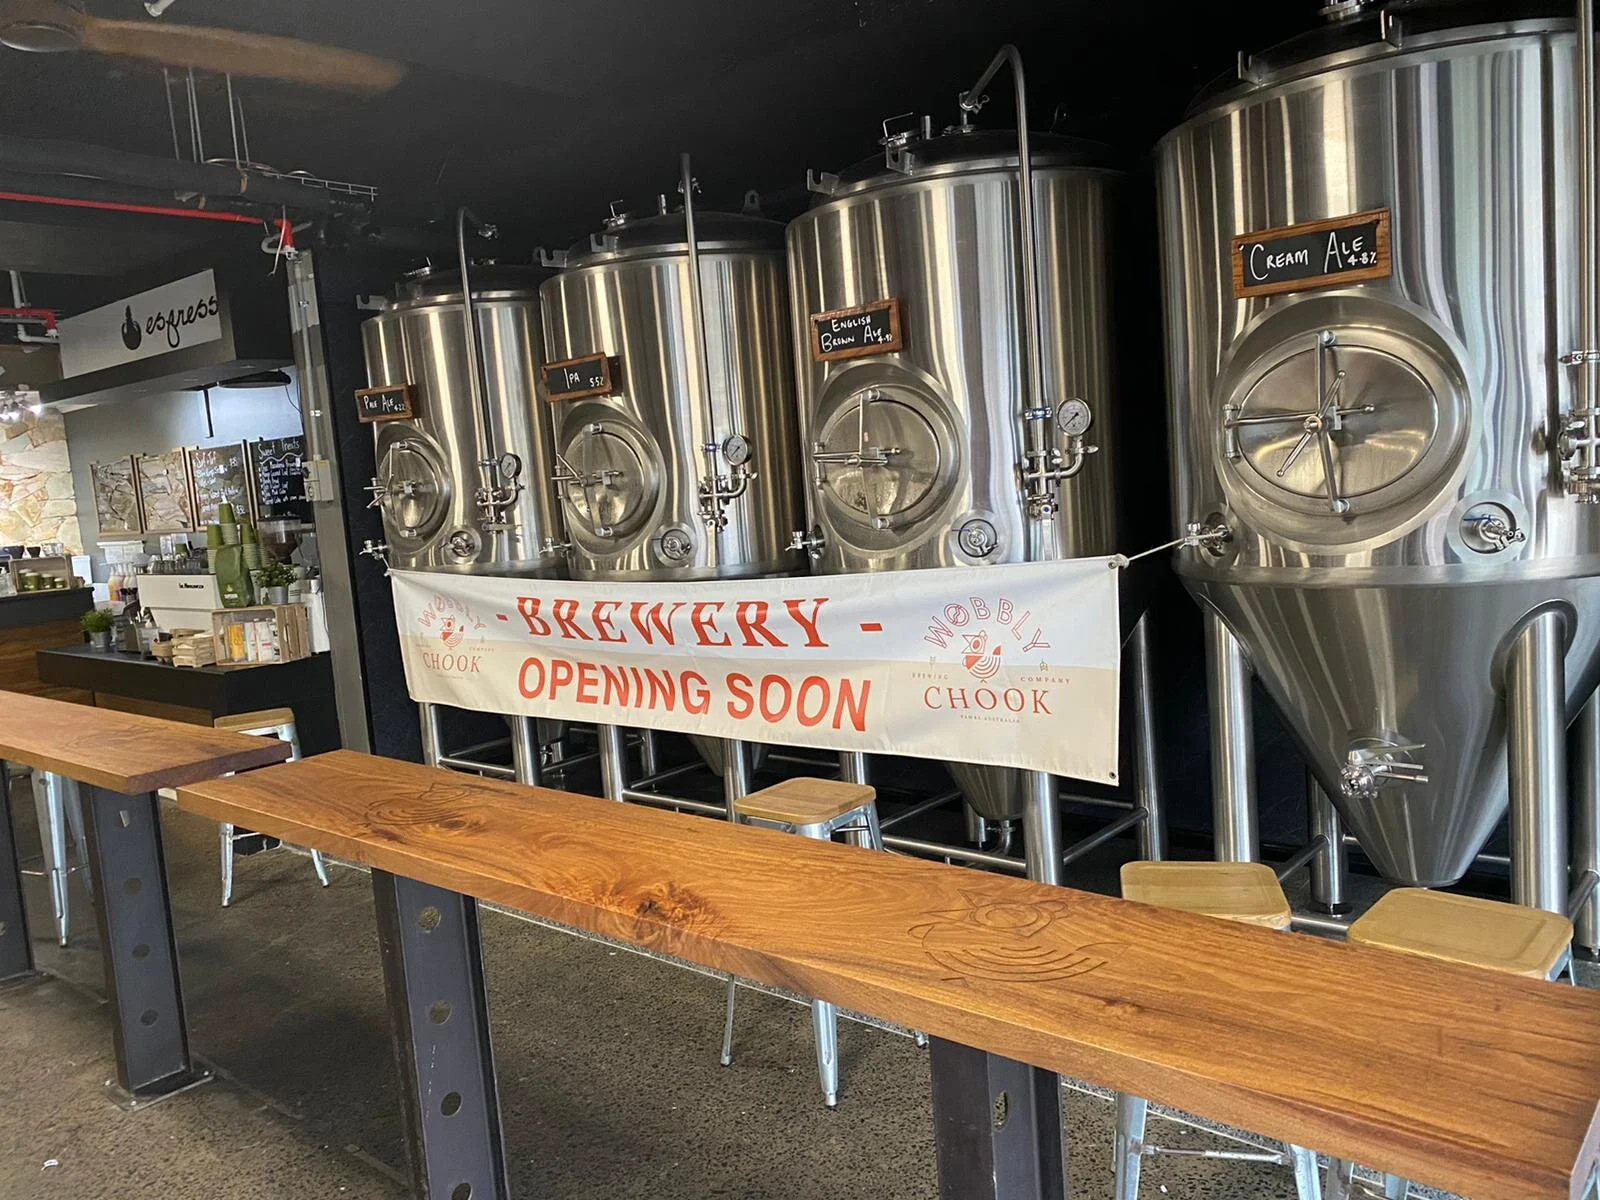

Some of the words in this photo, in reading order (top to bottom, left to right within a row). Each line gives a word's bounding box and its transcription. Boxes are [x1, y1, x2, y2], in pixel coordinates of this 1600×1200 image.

[1249, 243, 1309, 281] CREAM
[1323, 231, 1364, 274] ALE
[831, 314, 872, 332] ENGLISH
[516, 596, 830, 648] BREWERY
[923, 596, 1052, 654] WOBBLY
[423, 652, 481, 673] CHOOK
[1020, 676, 1071, 685] COMPANY
[518, 656, 712, 716] OPENING
[726, 671, 871, 733] SOON
[923, 686, 1053, 716] CHOOK
